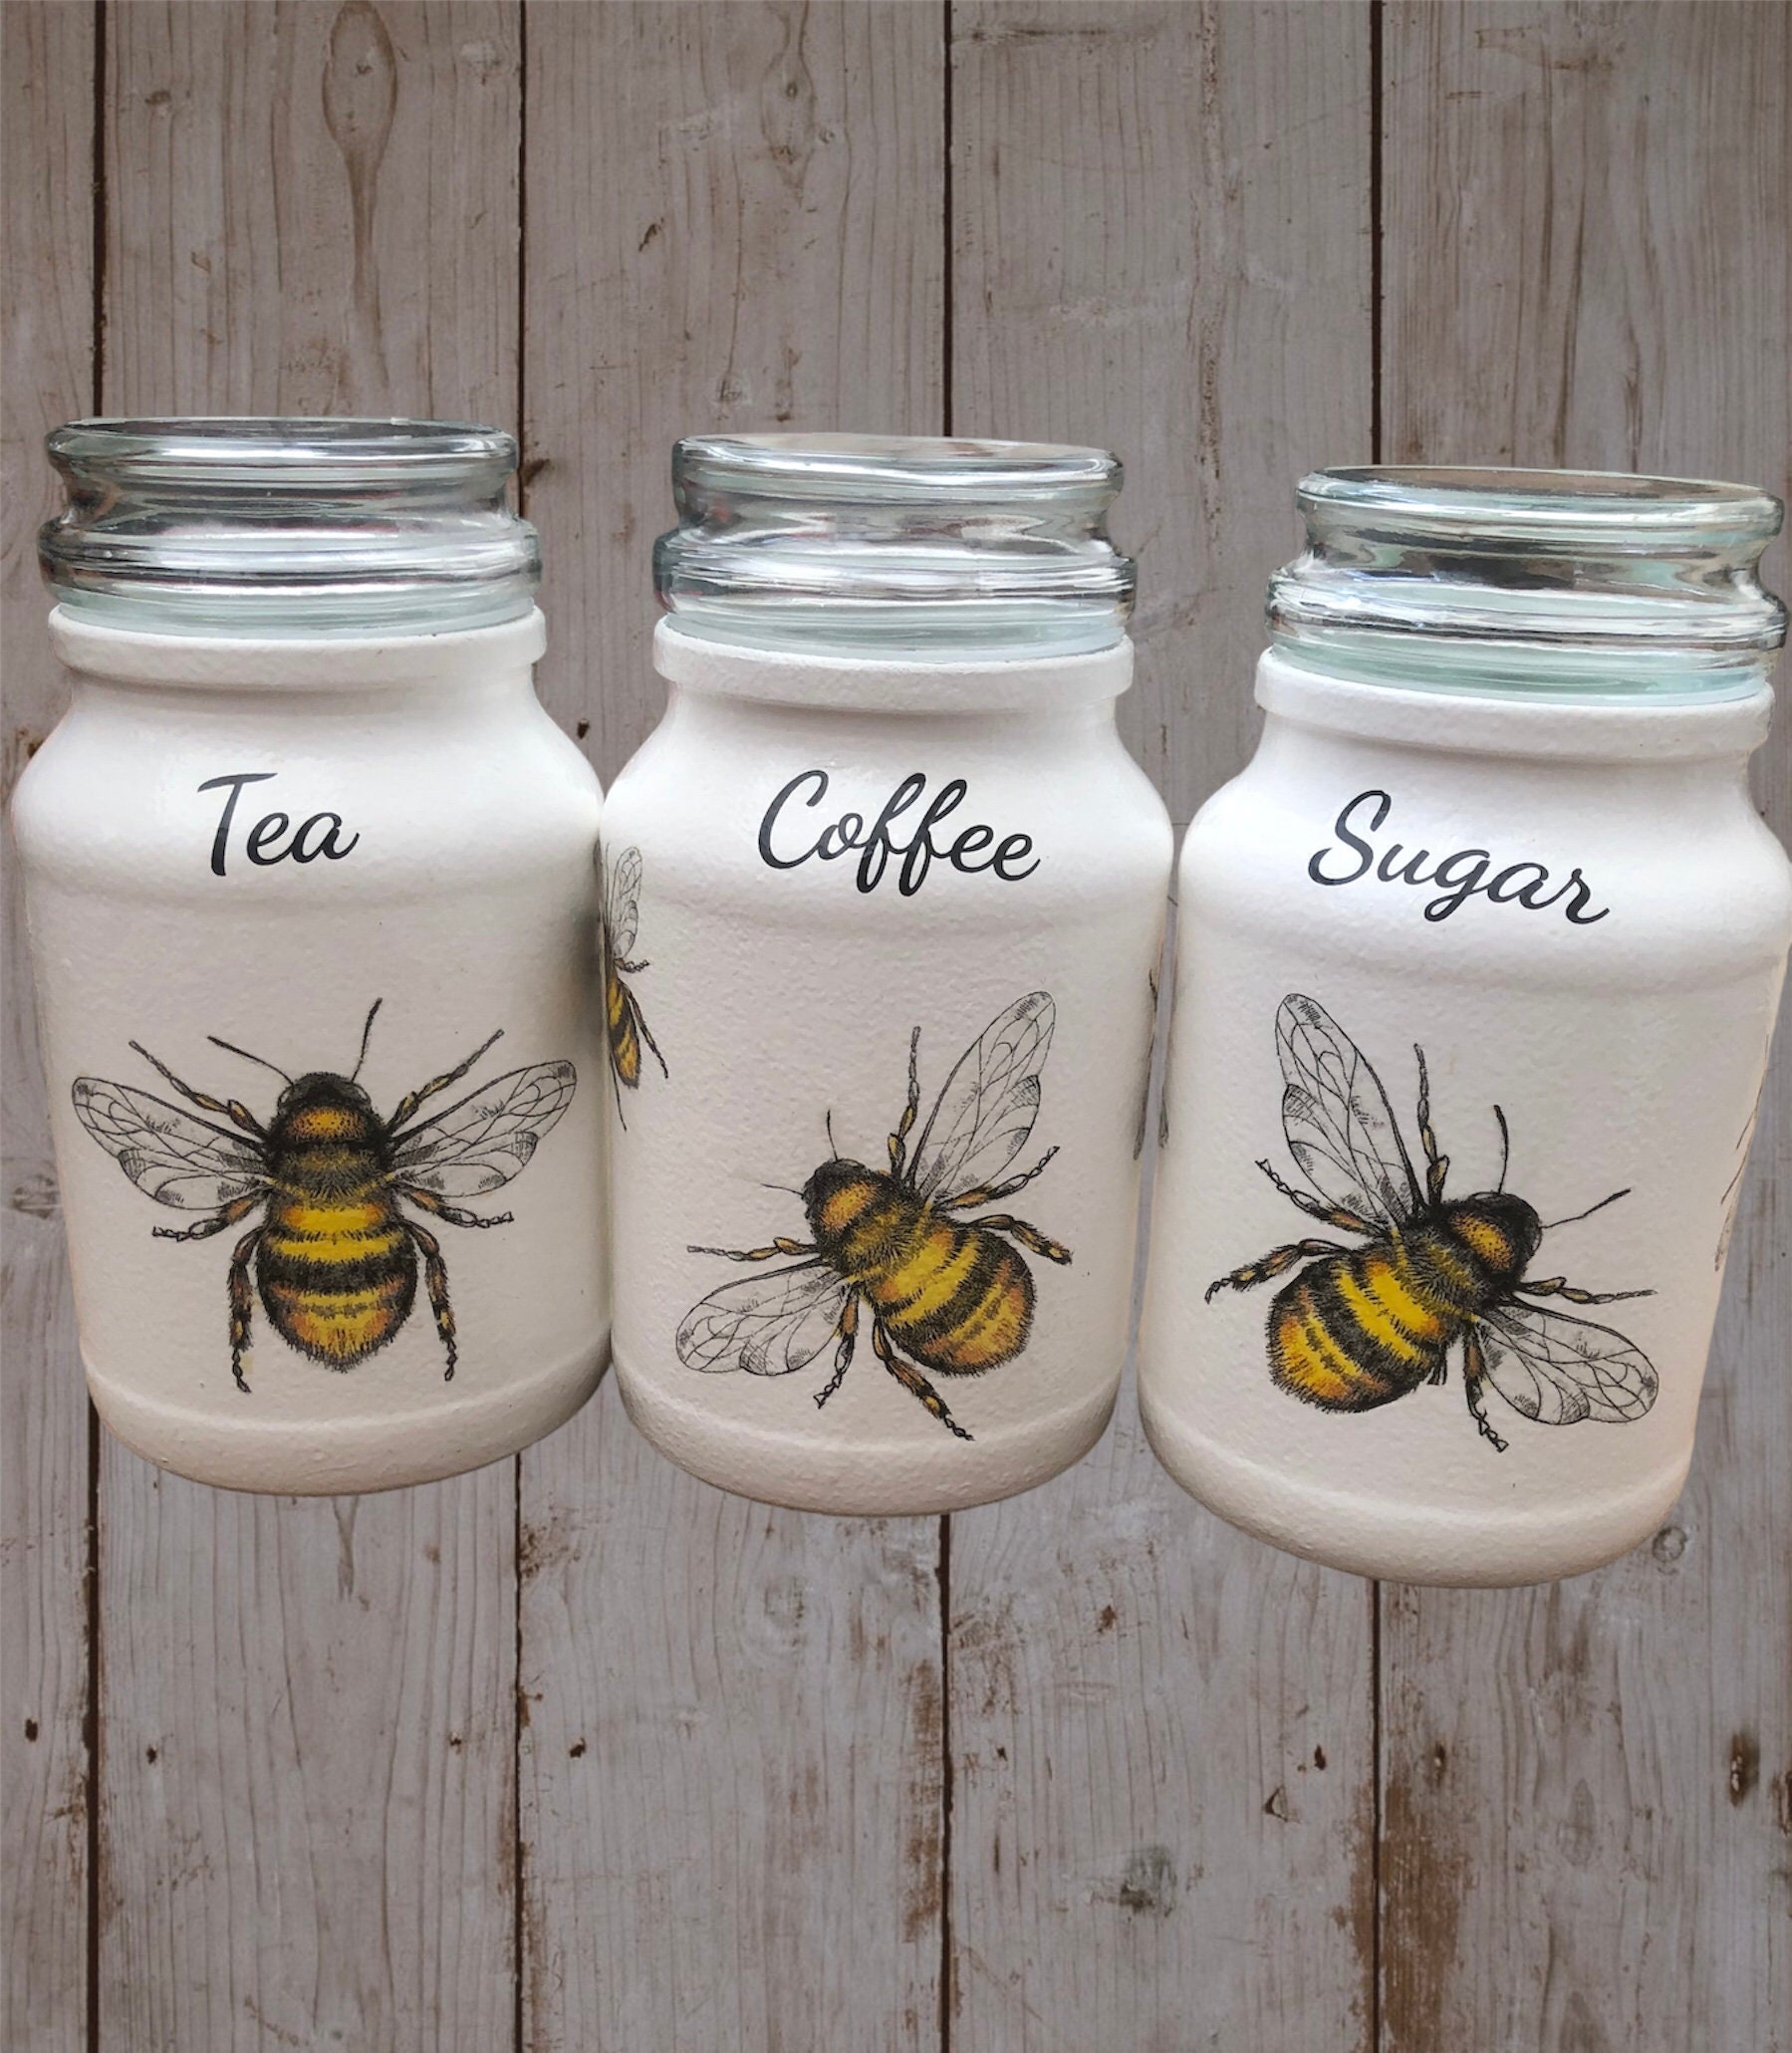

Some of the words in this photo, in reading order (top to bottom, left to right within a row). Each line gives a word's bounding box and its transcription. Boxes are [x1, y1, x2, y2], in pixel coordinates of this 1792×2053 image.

[197, 772, 361, 878] Tea
[758, 769, 1041, 898] Coffee
[1308, 789, 1611, 925] Sugar
